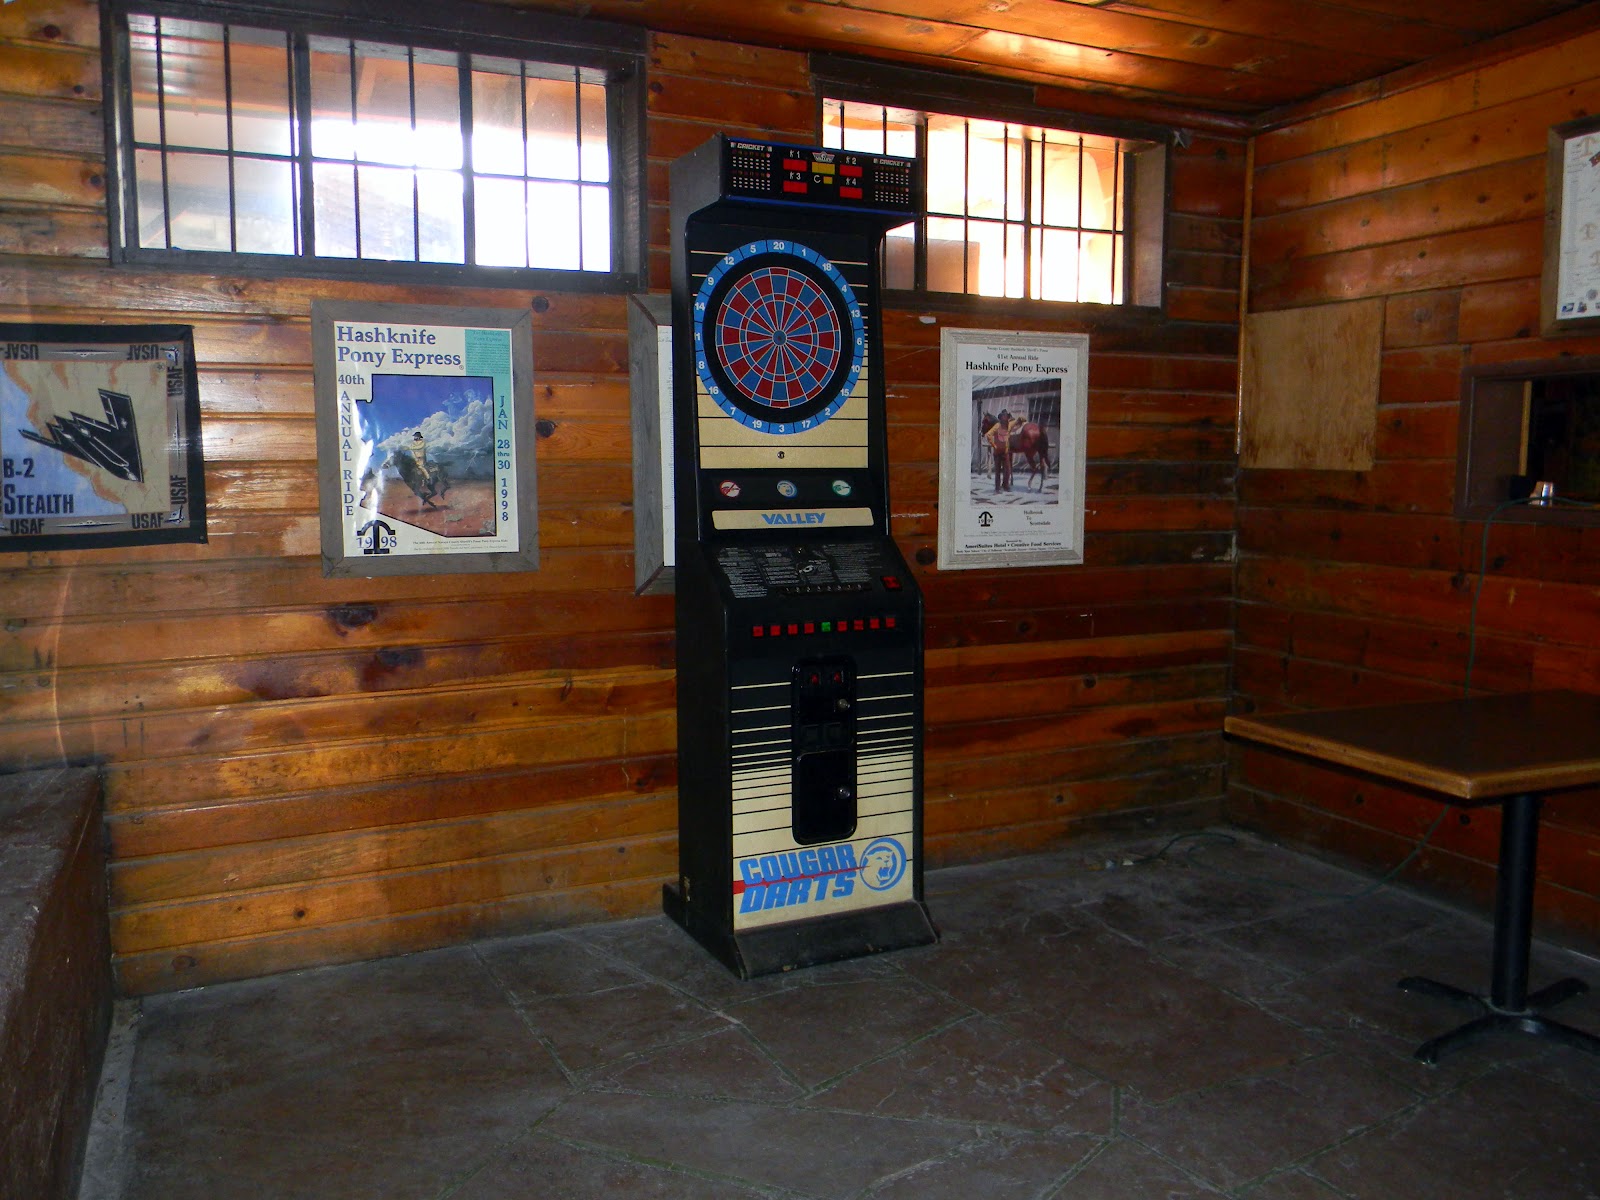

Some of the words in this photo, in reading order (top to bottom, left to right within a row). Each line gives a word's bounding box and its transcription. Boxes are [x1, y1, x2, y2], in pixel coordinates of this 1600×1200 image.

[737, 142, 765, 151] CRICKET
[852, 157, 857, 165] 2
[879, 159, 905, 167] CRICKET
[796, 173, 801, 181] 3
[852, 178, 857, 186] 4
[750, 245, 757, 253] 5
[773, 242, 785, 250] 20
[801, 248, 807, 256] 1
[724, 257, 735, 265] 12
[822, 263, 832, 272] 18
[707, 277, 715, 285] 9
[841, 284, 848, 293] 4
[694, 302, 706, 311] 14
[851, 309, 861, 318] 13
[336, 325, 436, 345] Hashknife
[856, 337, 863, 346] 6
[127, 343, 159, 361] USAF
[337, 346, 386, 368] Pony
[391, 348, 462, 369] Express
[698, 361, 705, 370] 8
[851, 364, 861, 373] 10
[965, 361, 1009, 372] Hashknife
[1012, 362, 1033, 374] Pony
[1036, 364, 1068, 375] Express
[167, 366, 184, 397] USAF
[338, 374, 365, 385] 40th
[708, 386, 719, 395] 16
[840, 388, 850, 397] 15
[498, 395, 508, 430] JAN
[729, 406, 737, 415] 7
[824, 408, 831, 416] 2
[340, 390, 353, 461] ANNUAL
[752, 420, 763, 429] 19
[778, 424, 785, 433] 3
[801, 420, 812, 428] 17
[497, 439, 510, 449] 28
[3, 457, 35, 478] B-2
[497, 460, 511, 470] 30
[170, 475, 188, 505] USAF
[343, 469, 355, 516] RIDE
[131, 512, 164, 529] USAF
[761, 512, 826, 525] VALLEY
[10, 518, 45, 535] USAF
[739, 843, 858, 885] COUGAR
[739, 870, 857, 914] DARTS
